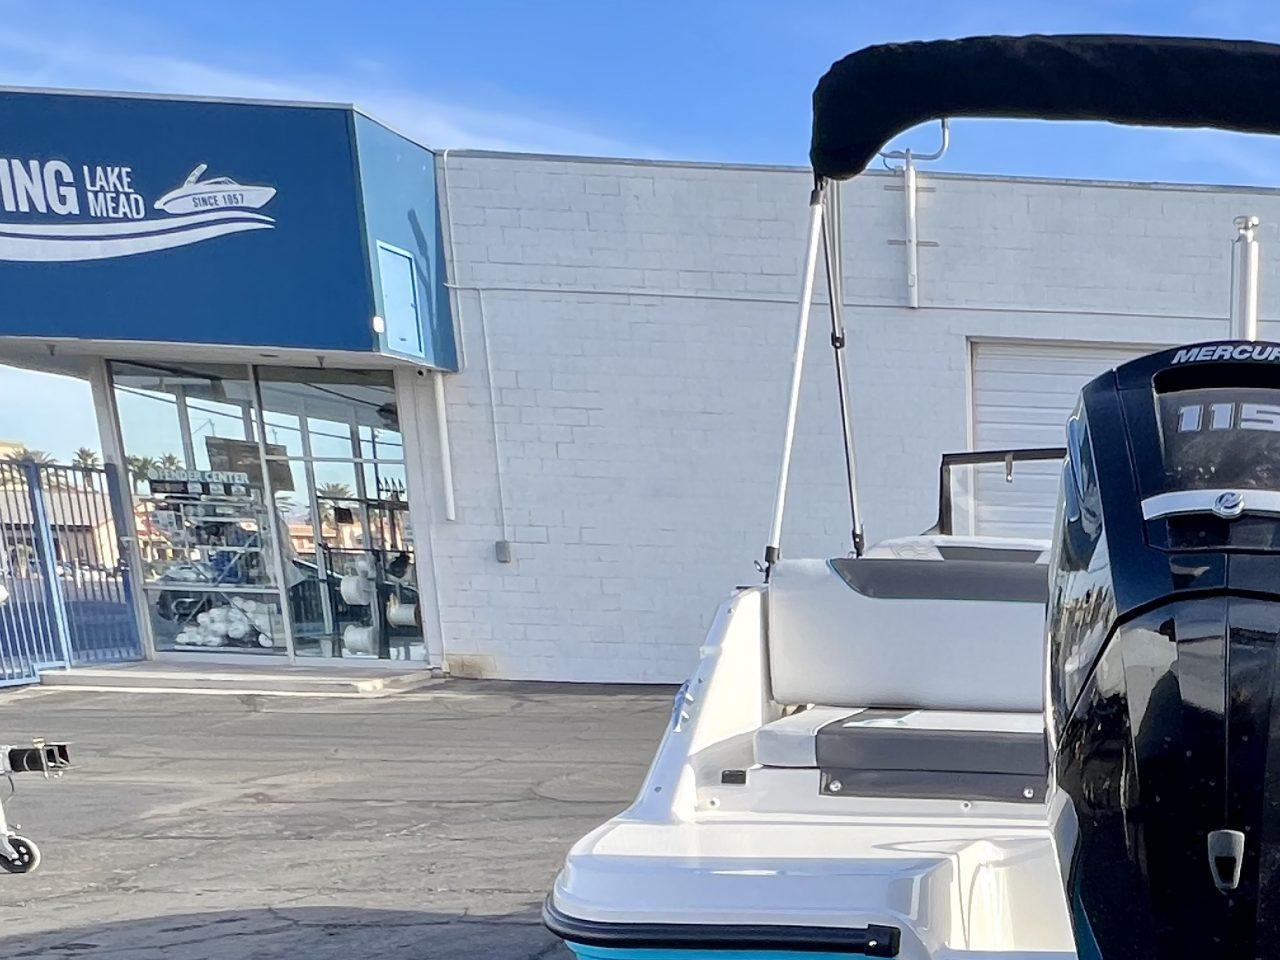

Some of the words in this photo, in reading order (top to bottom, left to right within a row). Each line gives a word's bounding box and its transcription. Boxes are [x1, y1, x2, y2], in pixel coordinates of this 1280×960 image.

[83, 165, 135, 193] LAKE
[87, 192, 145, 219] MEAD
[192, 196, 219, 207] SINCE
[205, 470, 250, 484] CENTER
